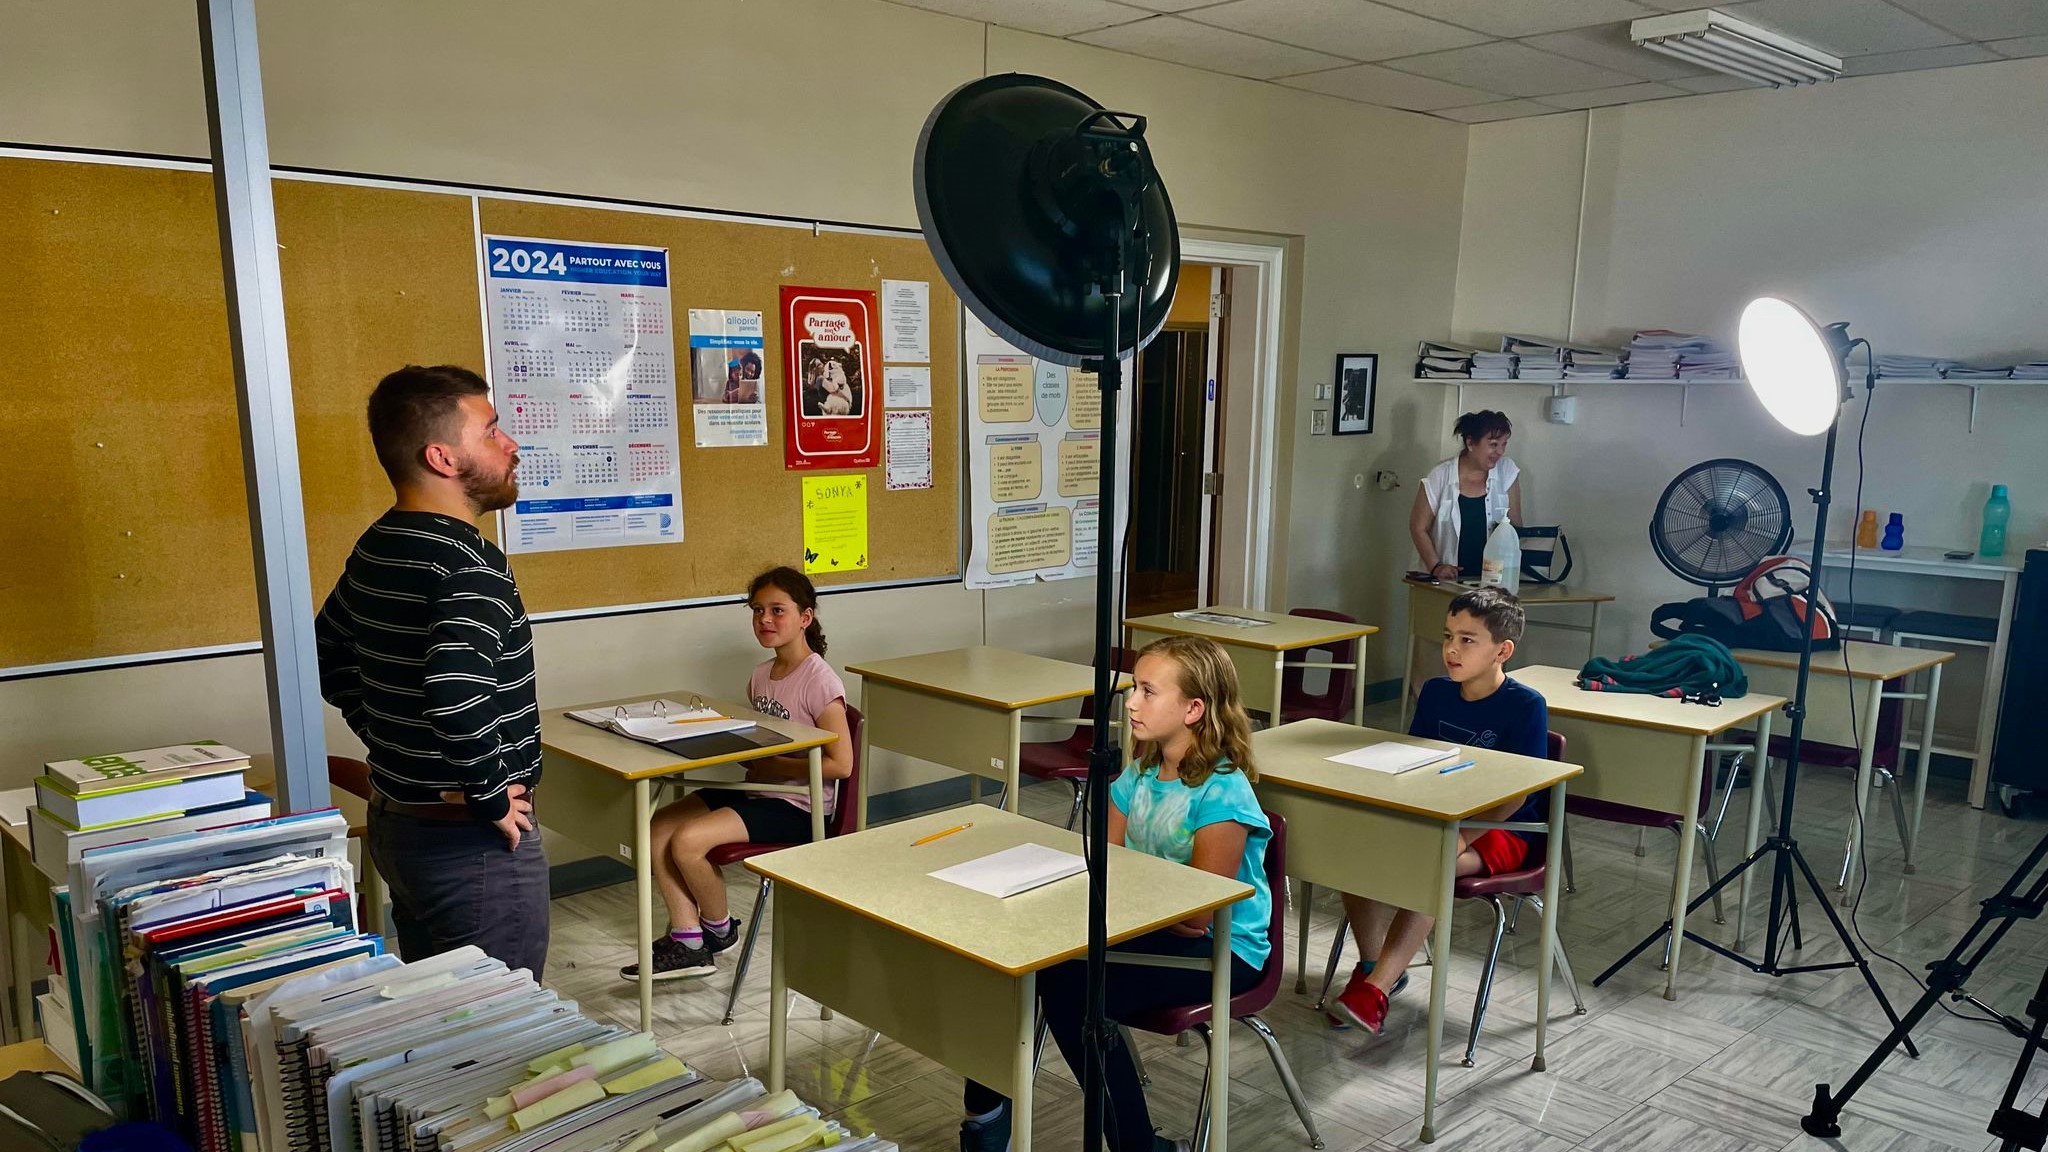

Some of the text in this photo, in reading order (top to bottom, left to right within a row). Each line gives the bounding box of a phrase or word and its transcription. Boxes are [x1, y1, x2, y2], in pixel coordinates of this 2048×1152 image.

[492, 247, 567, 276] 2024
[569, 256, 661, 270] PARTOUT AVEC VOUS
[726, 316, 758, 325] alloprof
[808, 317, 846, 332] Partage
[817, 333, 852, 343] amour
[1046, 371, 1056, 379] Des
[1040, 391, 1061, 399] de mots
[816, 483, 853, 500] SONYA
